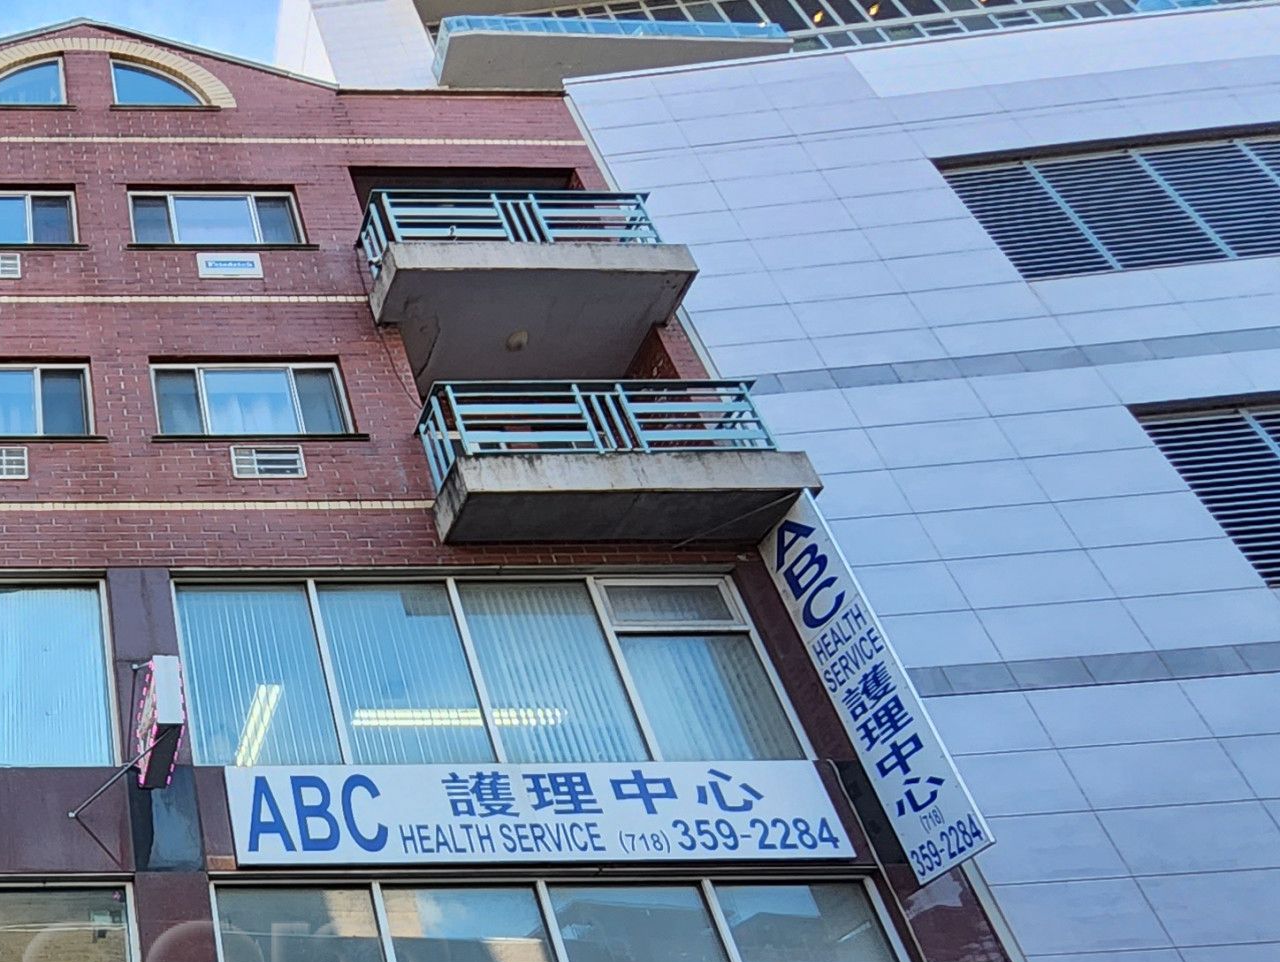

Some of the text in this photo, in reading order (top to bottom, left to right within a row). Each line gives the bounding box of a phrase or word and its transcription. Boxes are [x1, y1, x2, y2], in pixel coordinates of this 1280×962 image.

[776, 519, 846, 629] ABC
[811, 603, 868, 666] HEALTH
[823, 627, 885, 694] SERVICE
[841, 661, 946, 818] 護理中心
[248, 774, 389, 852] ABC
[441, 769, 764, 818] 護理中心
[919, 805, 945, 835] (718)
[399, 817, 840, 854] HEALTH SERVICE (718) 359-2284
[910, 813, 985, 877] 359-2284
